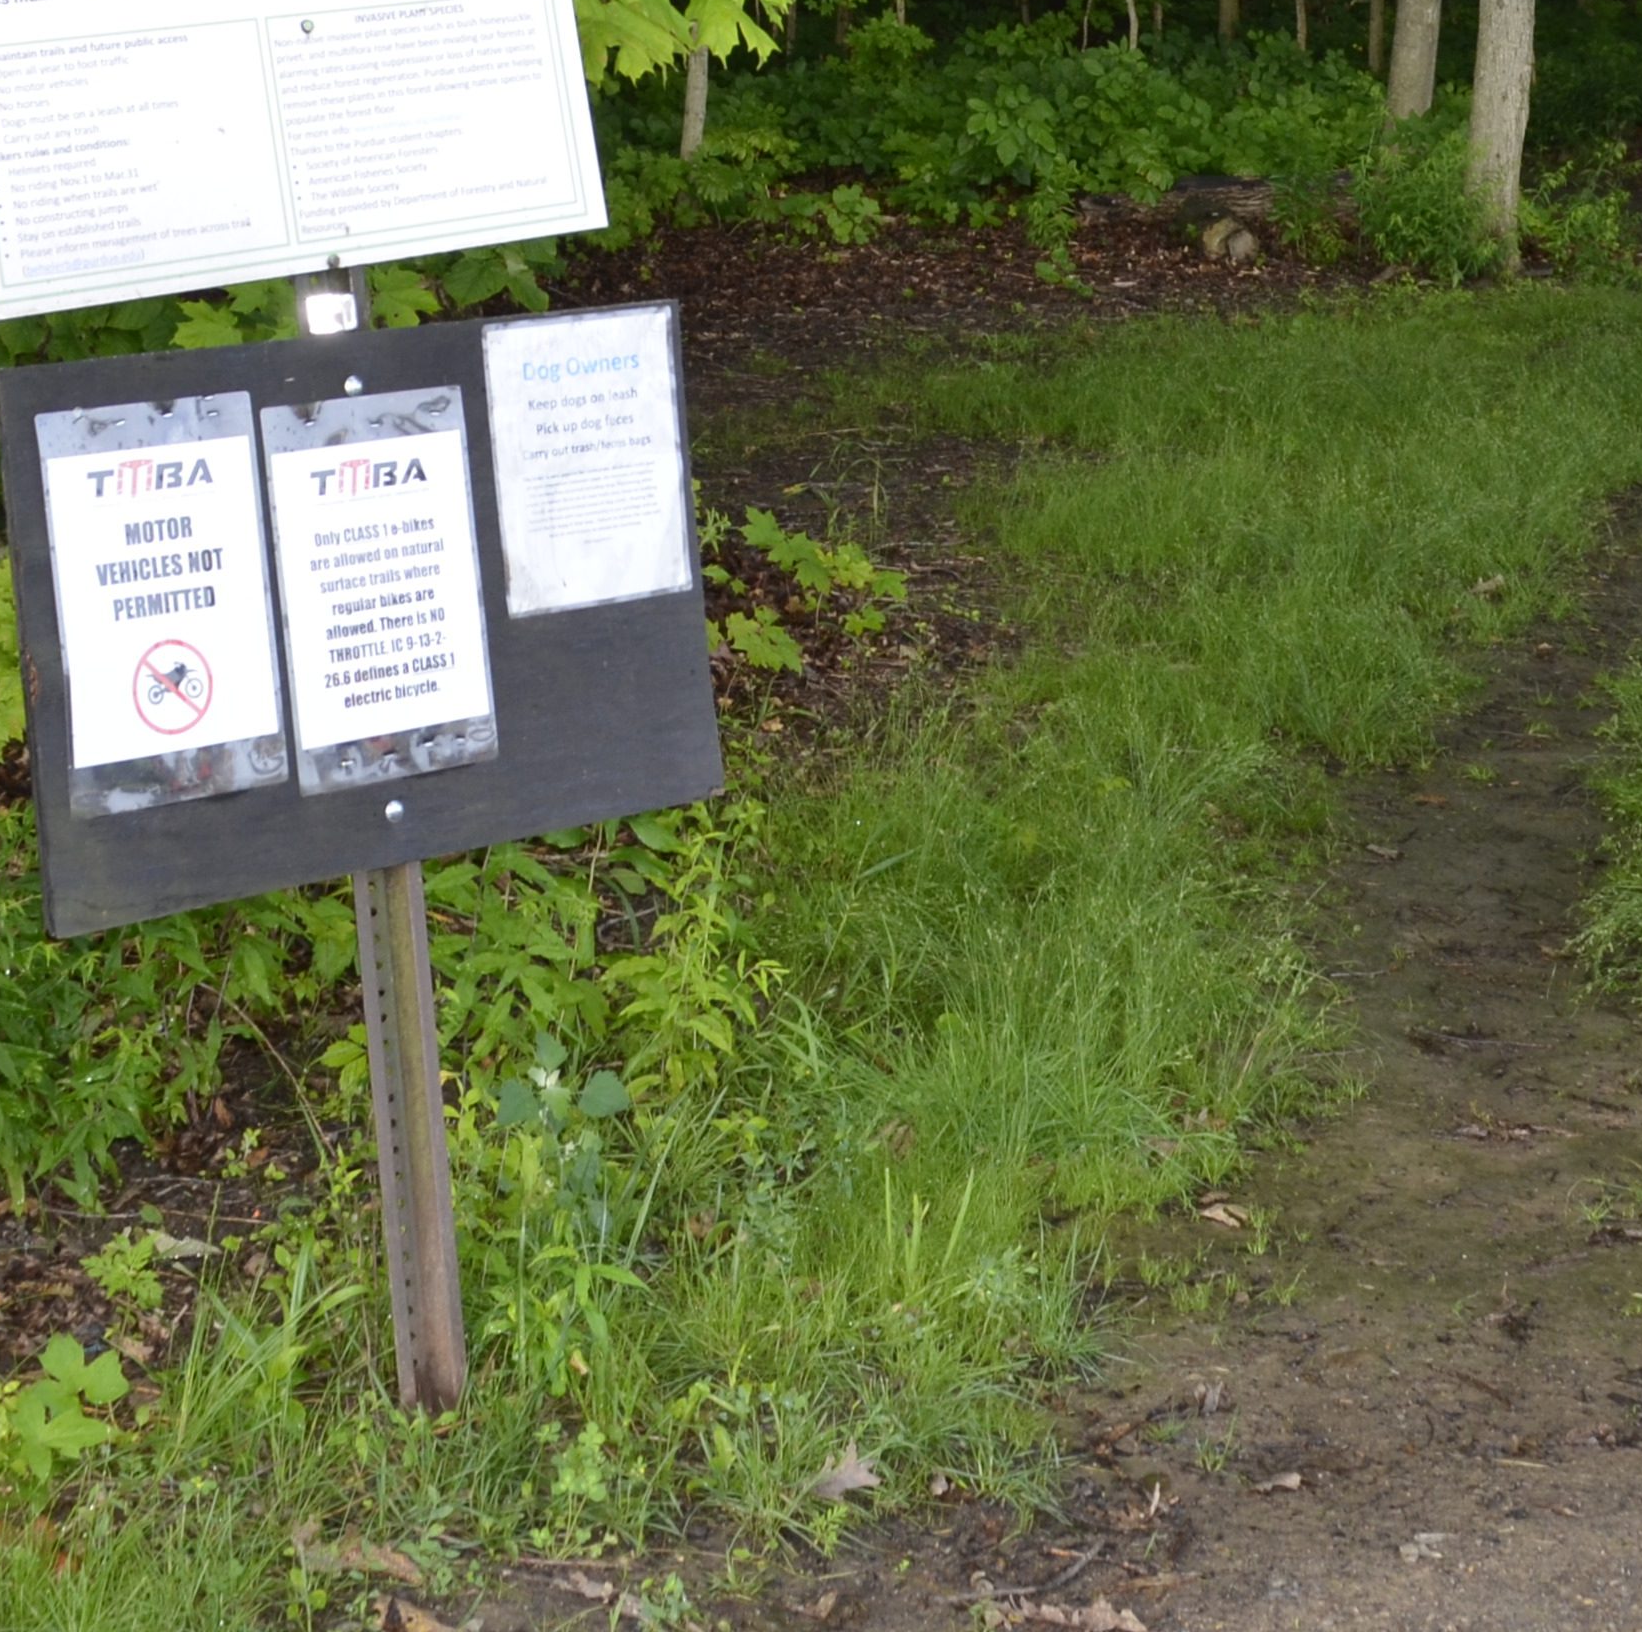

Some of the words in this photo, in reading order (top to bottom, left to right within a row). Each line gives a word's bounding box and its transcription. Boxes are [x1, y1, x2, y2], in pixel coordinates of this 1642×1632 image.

[39, 46, 66, 57] trails
[68, 43, 88, 54] and
[89, 42, 121, 52] future
[124, 37, 154, 50] public
[157, 35, 188, 45] access
[25, 65, 37, 76] all
[39, 64, 61, 75] year
[63, 62, 76, 71] to
[76, 59, 98, 70] foot
[100, 55, 129, 67] traffic
[14, 82, 45, 93] motor
[49, 77, 89, 89] vehicles
[1, 118, 27, 129] Dogs
[29, 114, 55, 124] must
[57, 112, 70, 122] be
[72, 111, 86, 120] on
[126, 104, 136, 113] at
[138, 101, 150, 112] all
[151, 100, 179, 110] times
[16, 99, 50, 109] horses
[3, 134, 31, 145] Carry
[33, 131, 51, 141] out
[54, 129, 72, 139] any
[24, 148, 51, 158] rules
[52, 144, 73, 155] and
[8, 164, 51, 177] Helmets
[53, 157, 97, 172] required
[10, 184, 26, 193] No
[28, 180, 58, 191] riding
[90, 174, 102, 184] to
[12, 200, 29, 210] No
[30, 196, 61, 207] riding
[62, 192, 91, 203] when
[92, 187, 118, 200] trails
[120, 187, 136, 196] are
[15, 215, 31, 227] No
[32, 207, 97, 225] constructing
[98, 204, 129, 218] jumps
[16, 232, 39, 244] Stay
[41, 230, 56, 240] on
[57, 220, 115, 238] established
[116, 217, 142, 230] trails
[19, 247, 53, 259] Please
[55, 242, 90, 255] inform
[91, 231, 158, 249] management
[159, 228, 170, 240] of
[171, 227, 198, 238] trees
[199, 222, 230, 234] across
[522, 361, 561, 384] Dog
[565, 352, 640, 377] Owners
[527, 399, 558, 411] Keep
[560, 395, 587, 408] dogs
[590, 393, 605, 404] on
[536, 421, 560, 436] Pick
[563, 422, 578, 435] up
[580, 417, 602, 431] dog
[551, 445, 569, 457] out
[629, 435, 652, 447] bags
[87, 458, 213, 498] TMBA
[310, 458, 427, 496] TMBA
[124, 516, 193, 546] MOTOR
[314, 531, 341, 547] Only
[343, 524, 380, 543] CLASS
[383, 523, 388, 536] 1
[390, 518, 435, 536] e-bikes
[96, 553, 183, 586] VEHICLES
[188, 548, 223, 573] NOT
[310, 558, 330, 572] are
[333, 547, 381, 568] allowed
[384, 547, 399, 560] on
[401, 538, 444, 557] natural
[320, 576, 367, 594] surface
[369, 569, 402, 586] trails
[403, 564, 440, 580] where
[113, 585, 216, 622] PERMITTED
[332, 598, 376, 616] regular
[379, 592, 413, 608] bikes
[415, 588, 435, 602] are
[326, 619, 377, 640] allowed.
[379, 615, 414, 631] There
[416, 612, 427, 625] is
[430, 607, 445, 622] NO
[391, 638, 403, 653] IC
[324, 670, 351, 688] 26.6
[354, 664, 400, 683] defines
[412, 653, 447, 673] CLASS
[450, 652, 455, 666] 1
[344, 688, 392, 709] electric
